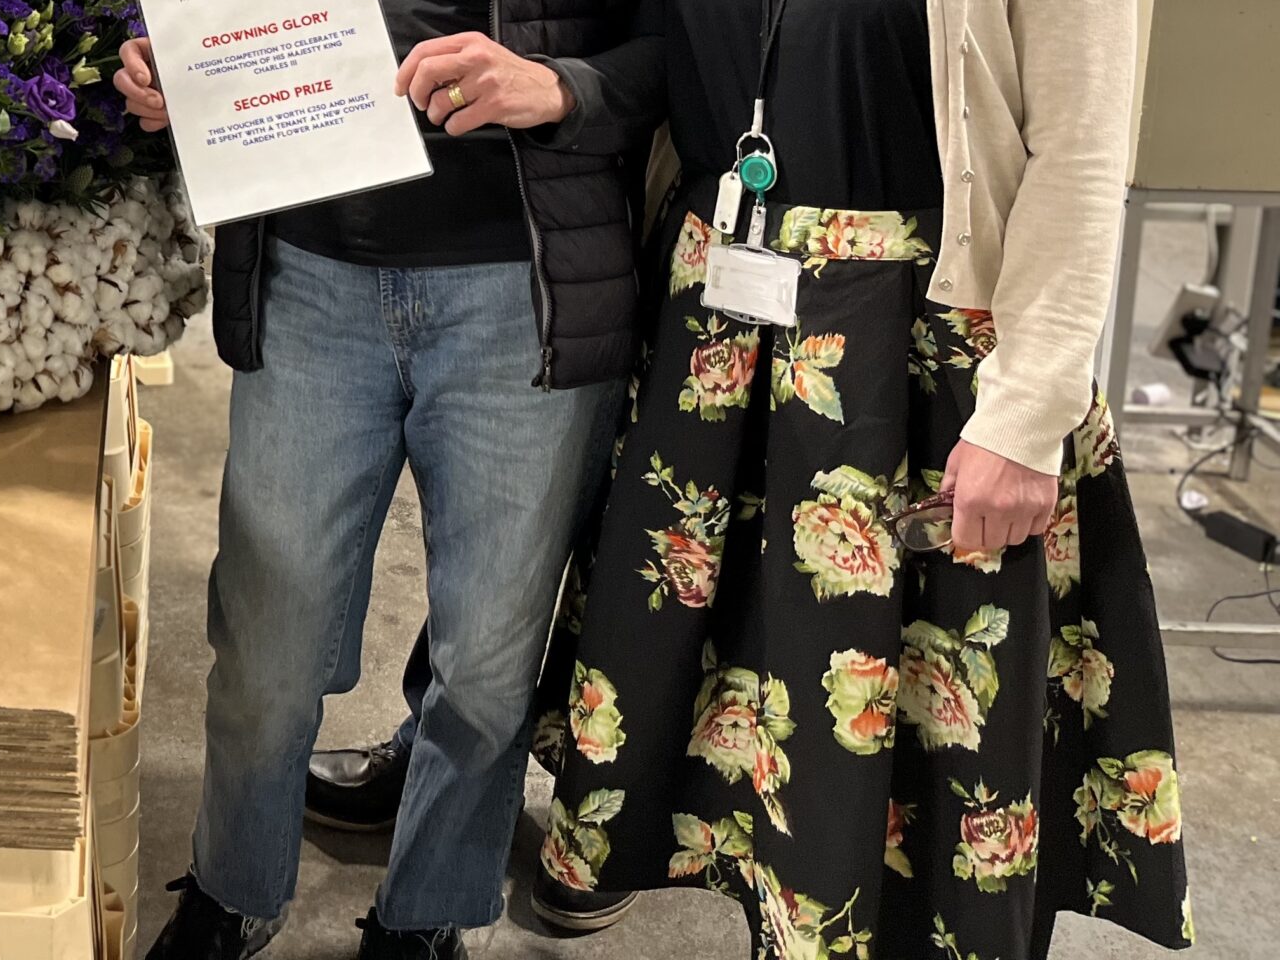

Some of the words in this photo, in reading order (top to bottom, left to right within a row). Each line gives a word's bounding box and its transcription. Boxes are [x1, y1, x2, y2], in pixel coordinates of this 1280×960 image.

[202, 23, 279, 49] CROWNING
[282, 10, 329, 31] GLORY
[187, 64, 194, 72] A
[194, 58, 223, 70] DESIGN
[224, 46, 279, 64] COMPETITION
[280, 42, 293, 51] TO
[293, 32, 340, 48] CELEBRATE
[340, 28, 357, 37] THE
[204, 58, 258, 77] CORONATION
[259, 56, 271, 65] OF
[272, 52, 286, 62] HIS
[287, 44, 322, 59] MAJESTY
[323, 39, 343, 50] KING
[253, 61, 289, 75] CHARLES
[290, 59, 298, 67] III
[207, 126, 226, 136] THIS
[226, 118, 265, 132] VOUCHER
[266, 115, 274, 124] IS
[275, 108, 306, 121] WORTH
[306, 103, 327, 114] £250
[328, 99, 346, 109] AND
[348, 93, 370, 104] MUST
[233, 89, 291, 112] SECOND
[294, 79, 334, 98] PRIZE
[206, 137, 217, 146] BE
[218, 132, 243, 143] SPENT
[244, 127, 266, 137] WITH
[267, 124, 274, 132] A
[276, 118, 308, 130] TENANT
[310, 113, 321, 122] AT
[322, 109, 341, 119] NEW
[343, 100, 376, 115] COVENT
[242, 133, 275, 147] GARDEN
[276, 125, 311, 138] FLOWER
[312, 116, 345, 130] MARKET
